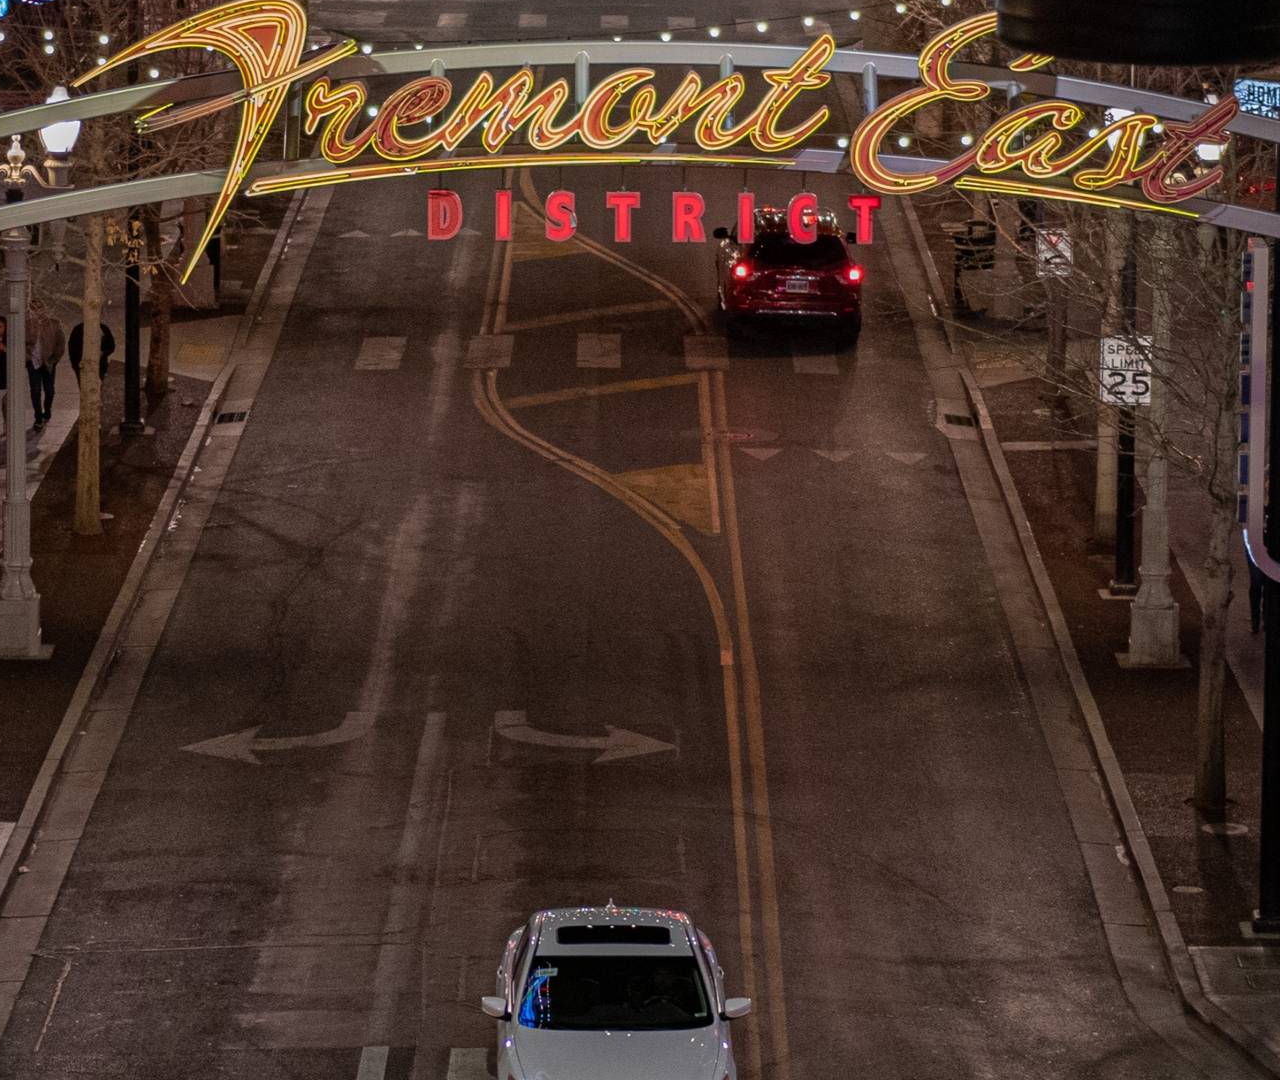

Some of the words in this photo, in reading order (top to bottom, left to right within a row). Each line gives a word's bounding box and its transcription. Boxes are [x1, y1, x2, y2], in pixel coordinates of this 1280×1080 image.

[850, 10, 1240, 203] East
[426, 189, 881, 246] DISTRICT
[1108, 372, 1150, 396] 25
[1111, 359, 1144, 369] LIMIT
